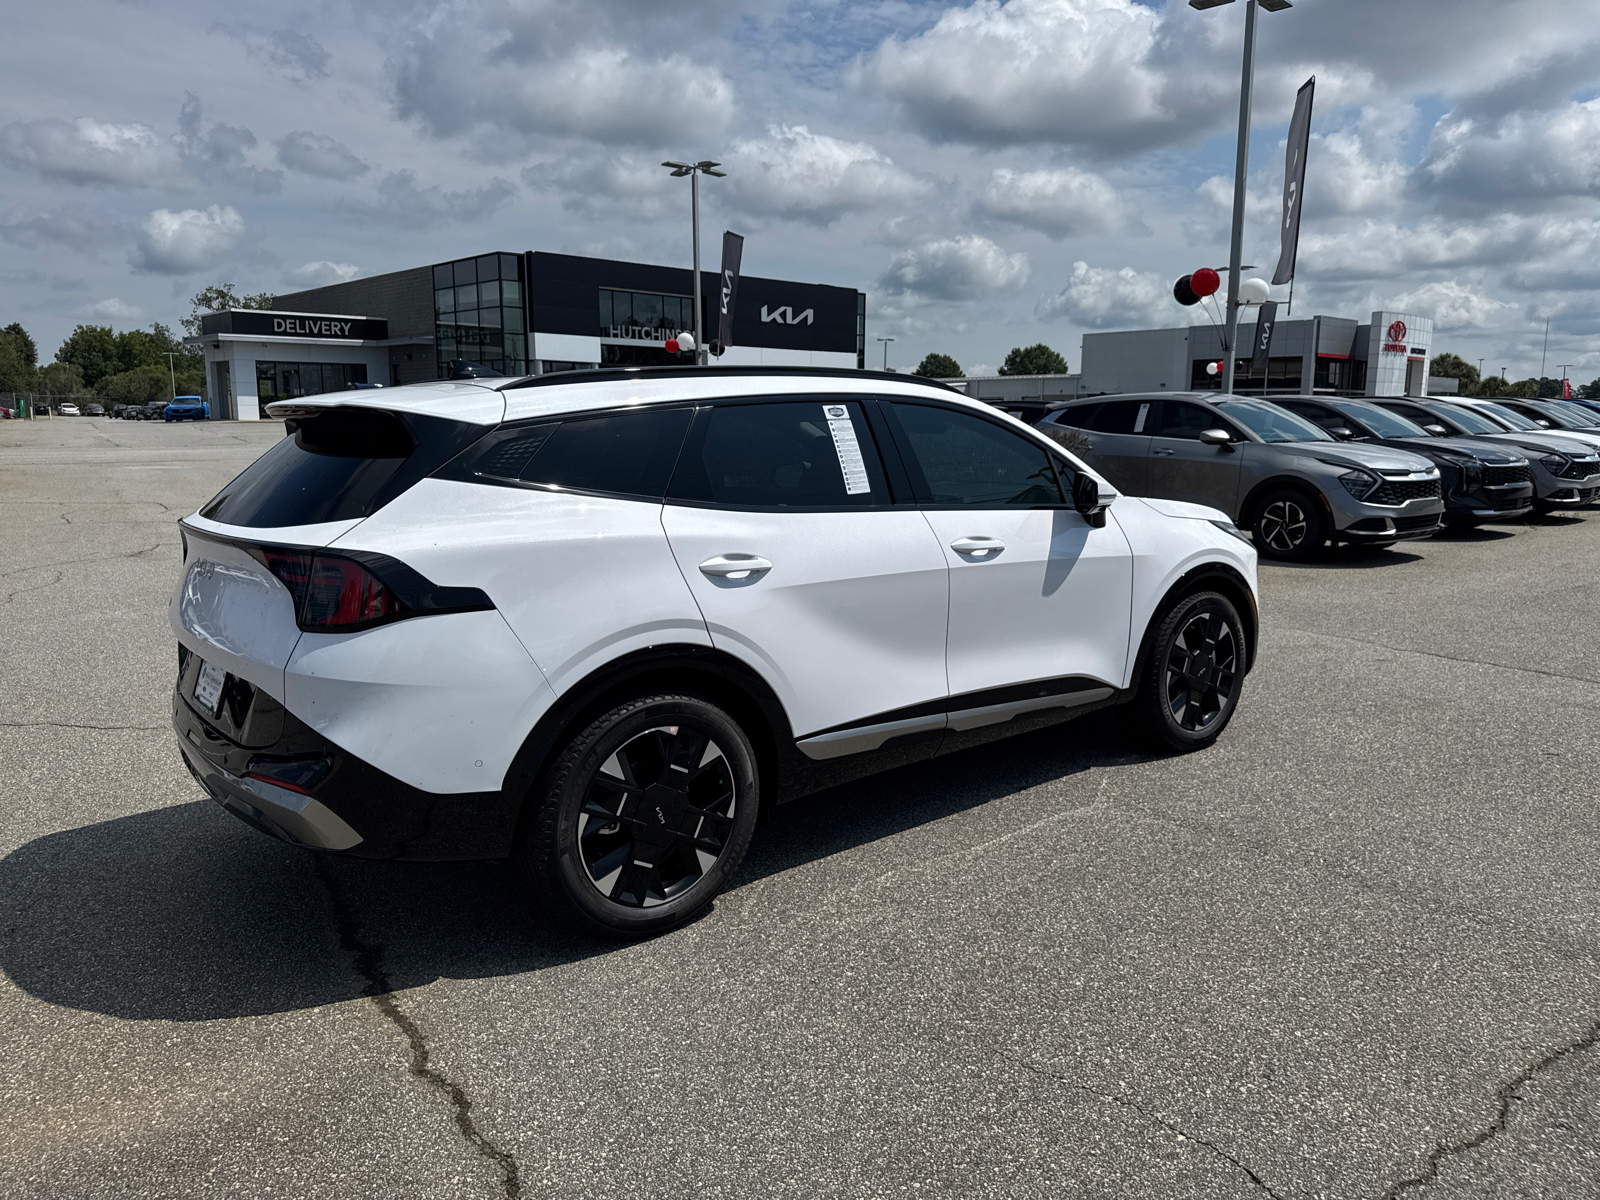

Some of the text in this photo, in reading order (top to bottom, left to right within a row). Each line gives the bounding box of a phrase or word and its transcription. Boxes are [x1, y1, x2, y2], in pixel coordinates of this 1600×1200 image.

[721, 268, 734, 315] KIA
[760, 304, 814, 326] KIA
[273, 318, 352, 336] DELIVERY
[610, 324, 696, 342] HUTCHIN
[1384, 343, 1406, 353] TOYOTA
